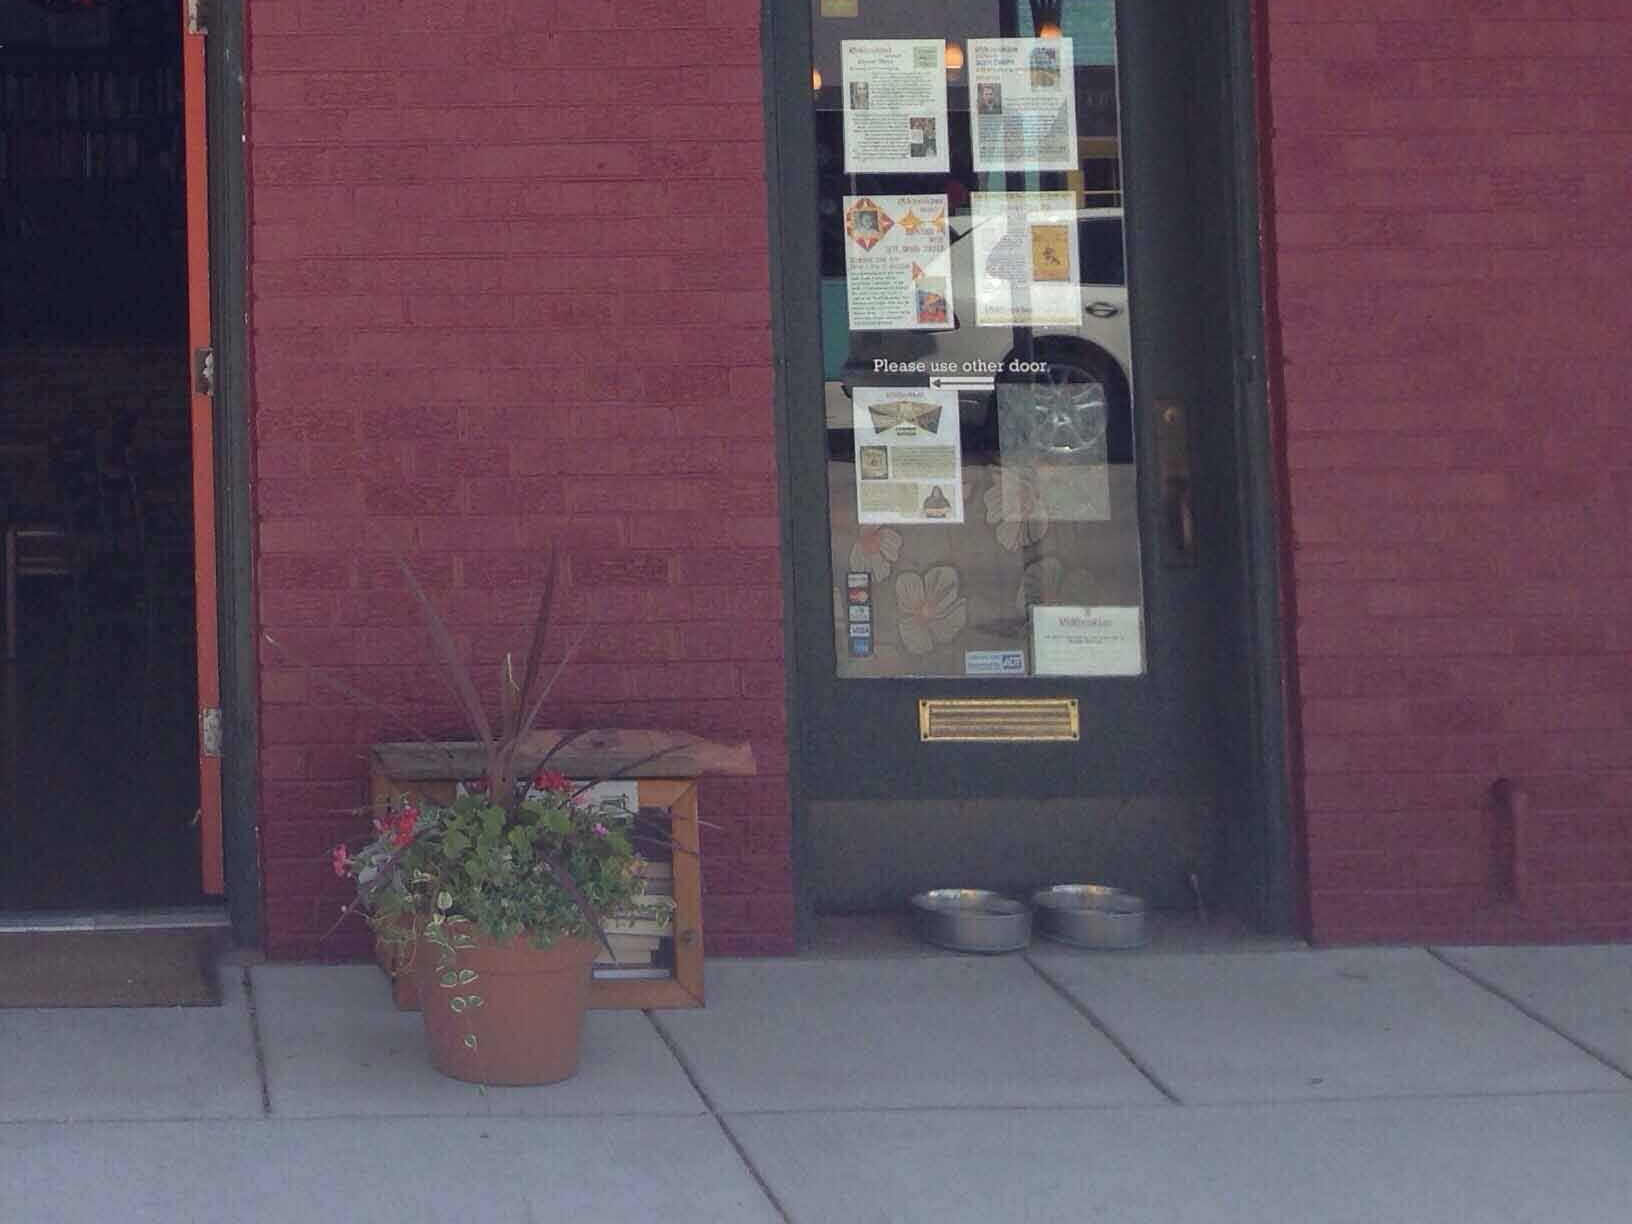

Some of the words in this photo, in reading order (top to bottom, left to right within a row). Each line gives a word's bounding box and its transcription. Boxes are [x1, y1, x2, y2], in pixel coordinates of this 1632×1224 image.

[873, 358, 926, 373] Please
[930, 361, 958, 373] use
[962, 358, 1004, 373] other
